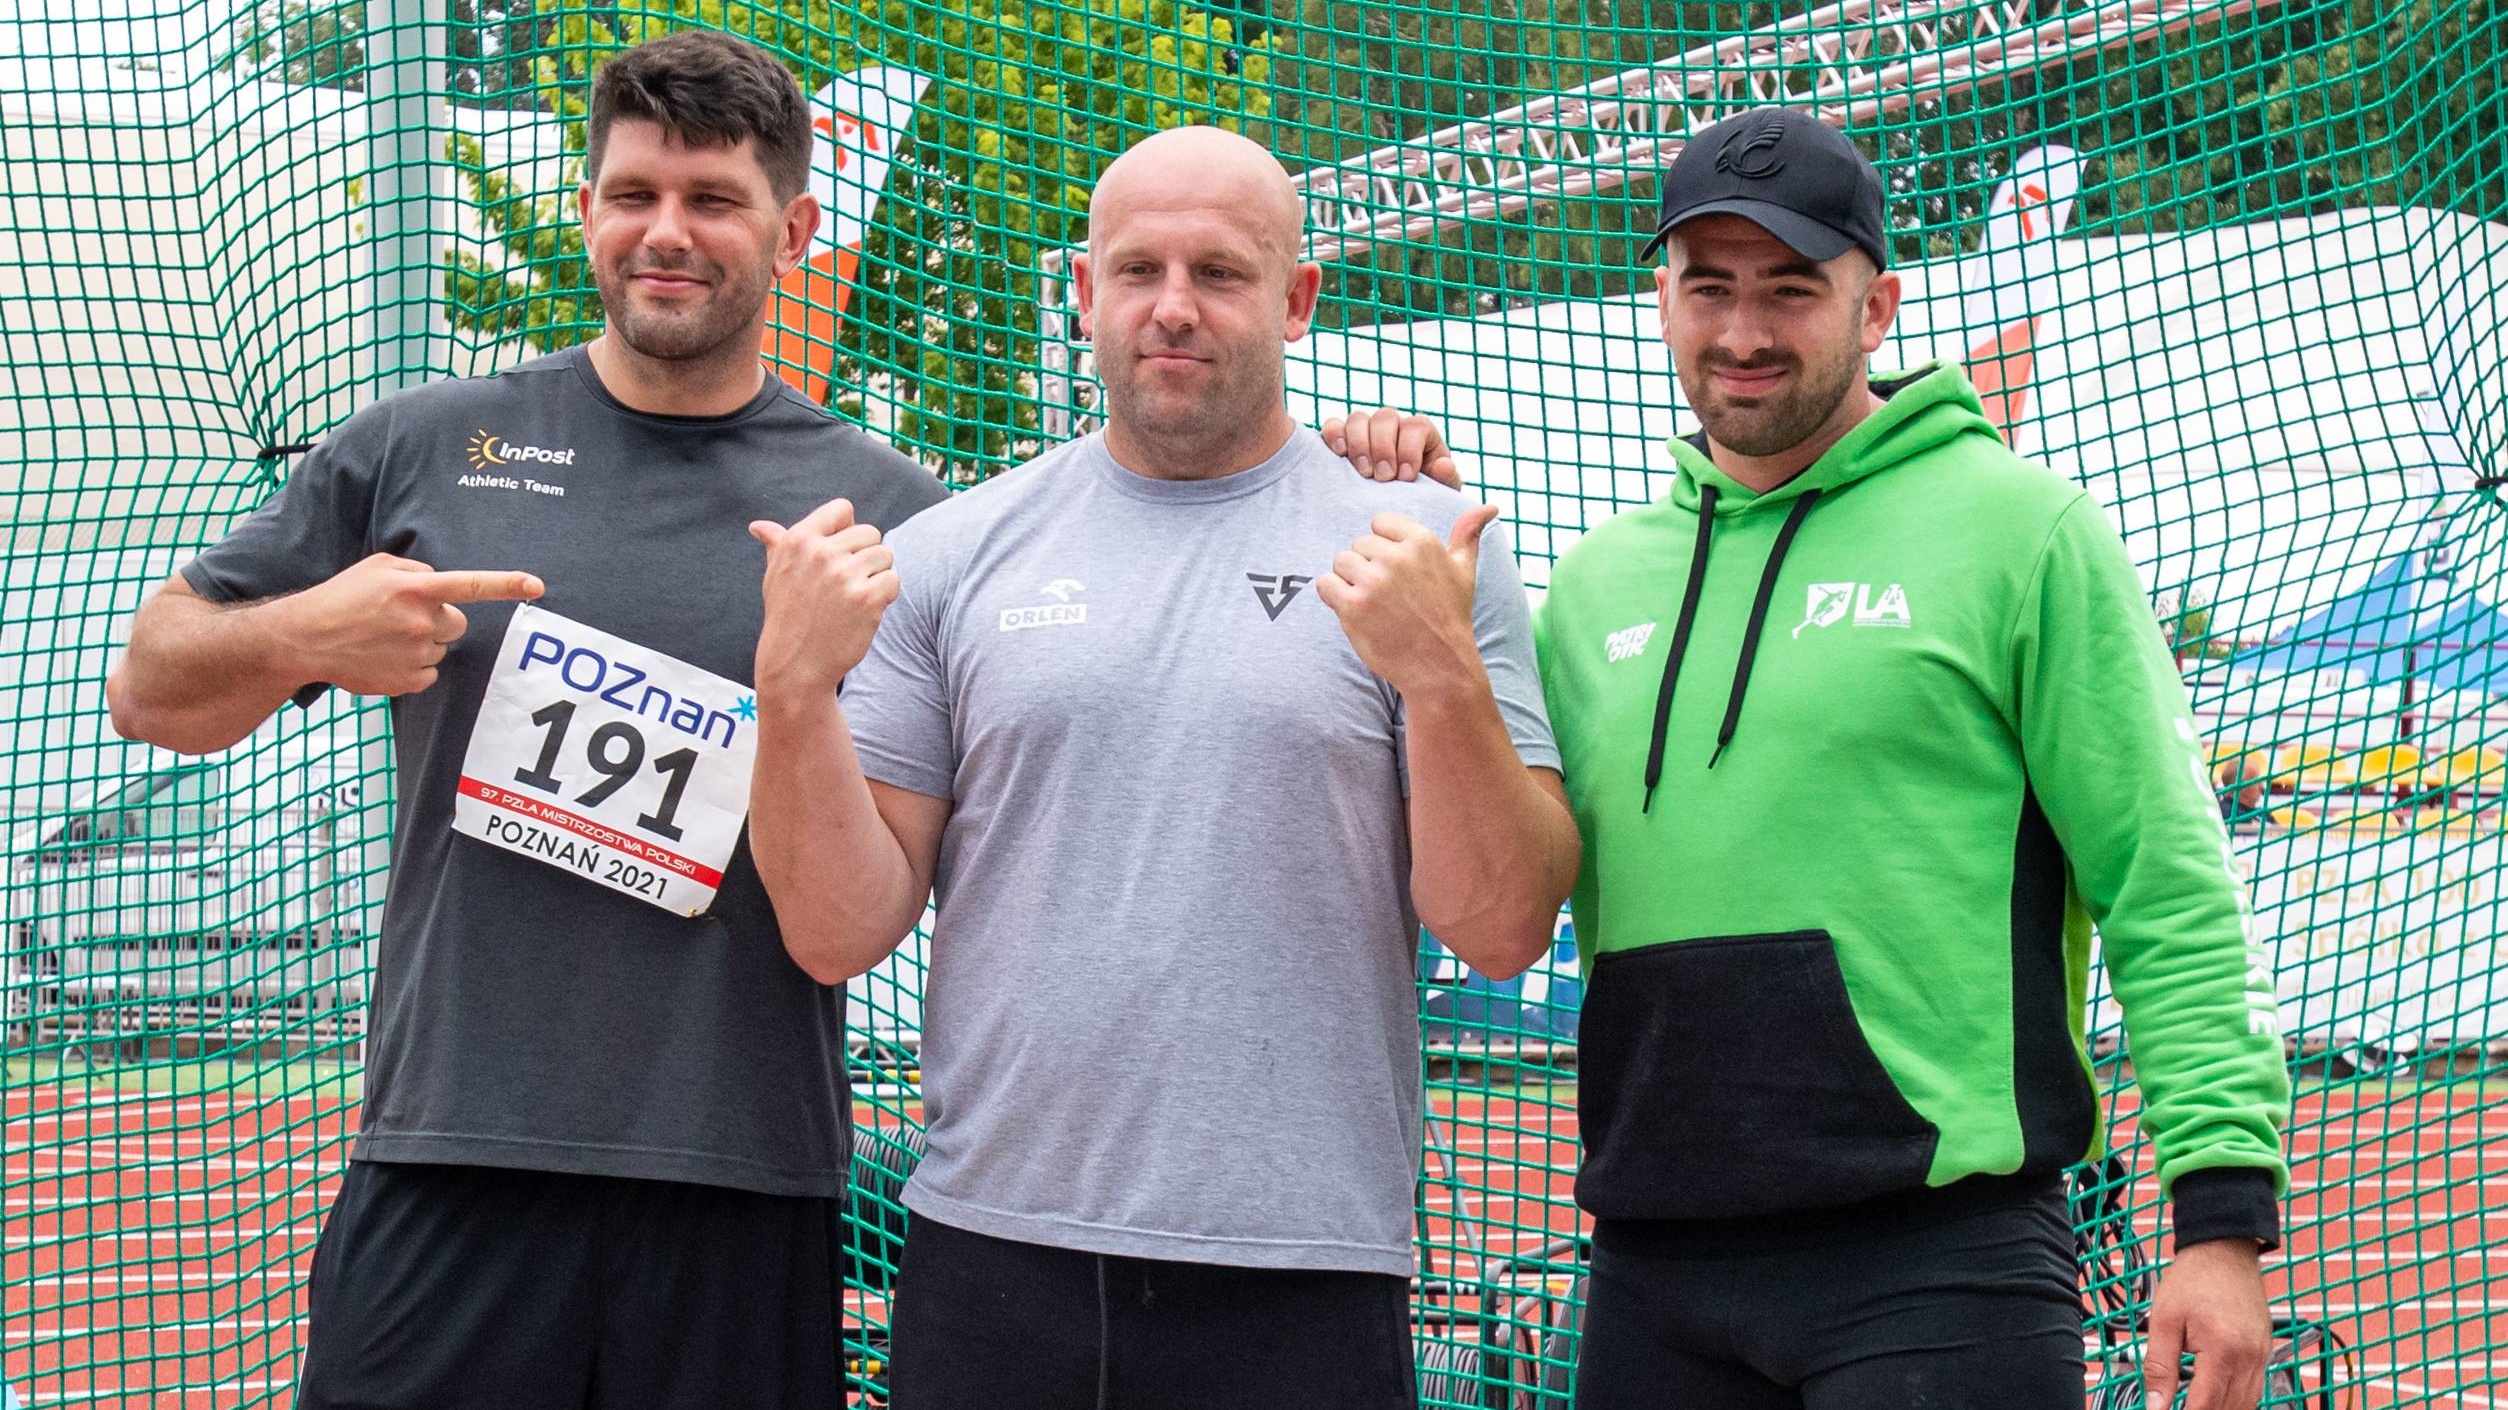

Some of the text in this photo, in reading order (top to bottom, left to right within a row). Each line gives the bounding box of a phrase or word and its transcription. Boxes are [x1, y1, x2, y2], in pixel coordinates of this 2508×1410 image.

[499, 442, 575, 465] InPost
[457, 474, 565, 497] Athletic Team
[1005, 607, 1081, 627] ORLEN
[513, 700, 699, 843] 191
[480, 787, 697, 875] 97. PZLA MISTRZOSTWA POLSKI
[485, 814, 668, 900] POZNAŃ 2021
